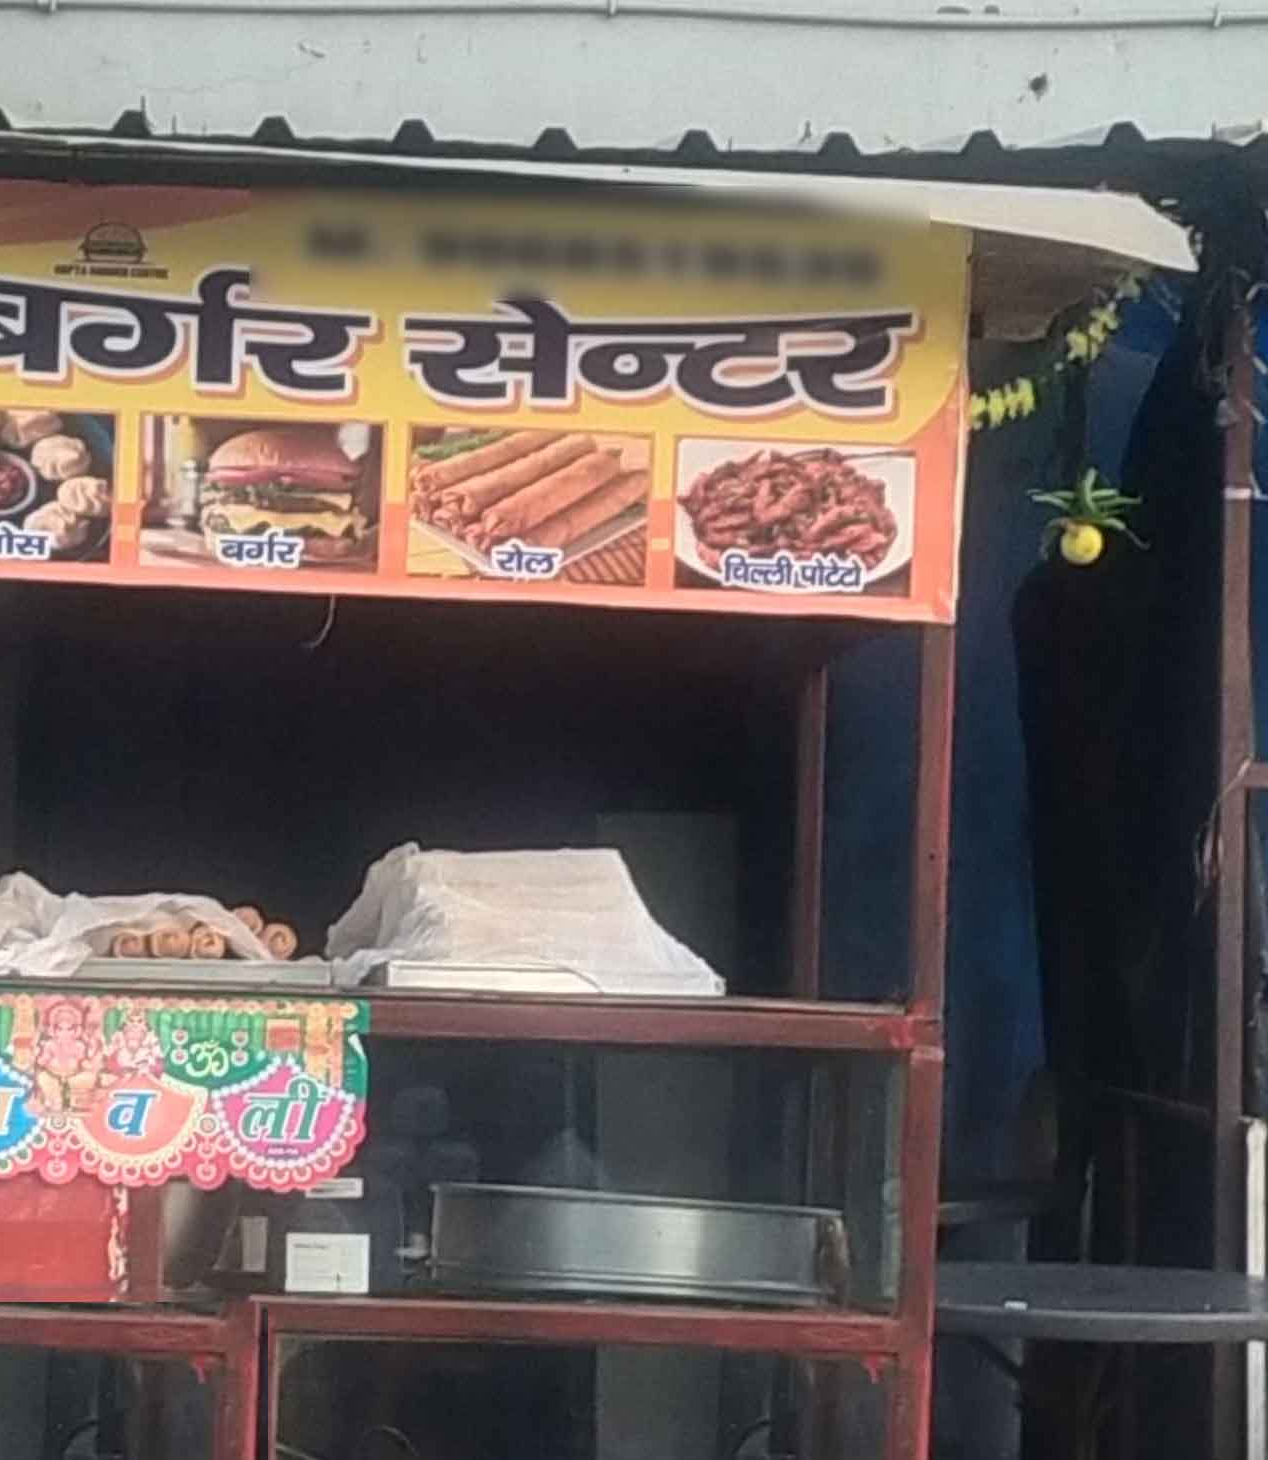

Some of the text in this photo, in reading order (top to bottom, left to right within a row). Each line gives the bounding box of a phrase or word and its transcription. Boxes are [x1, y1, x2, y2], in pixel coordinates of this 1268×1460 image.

[404, 292, 912, 408] सेन्टर
[219, 529, 301, 564] बर्गर
[495, 543, 560, 574] रोल
[724, 554, 792, 585] चिल्ली
